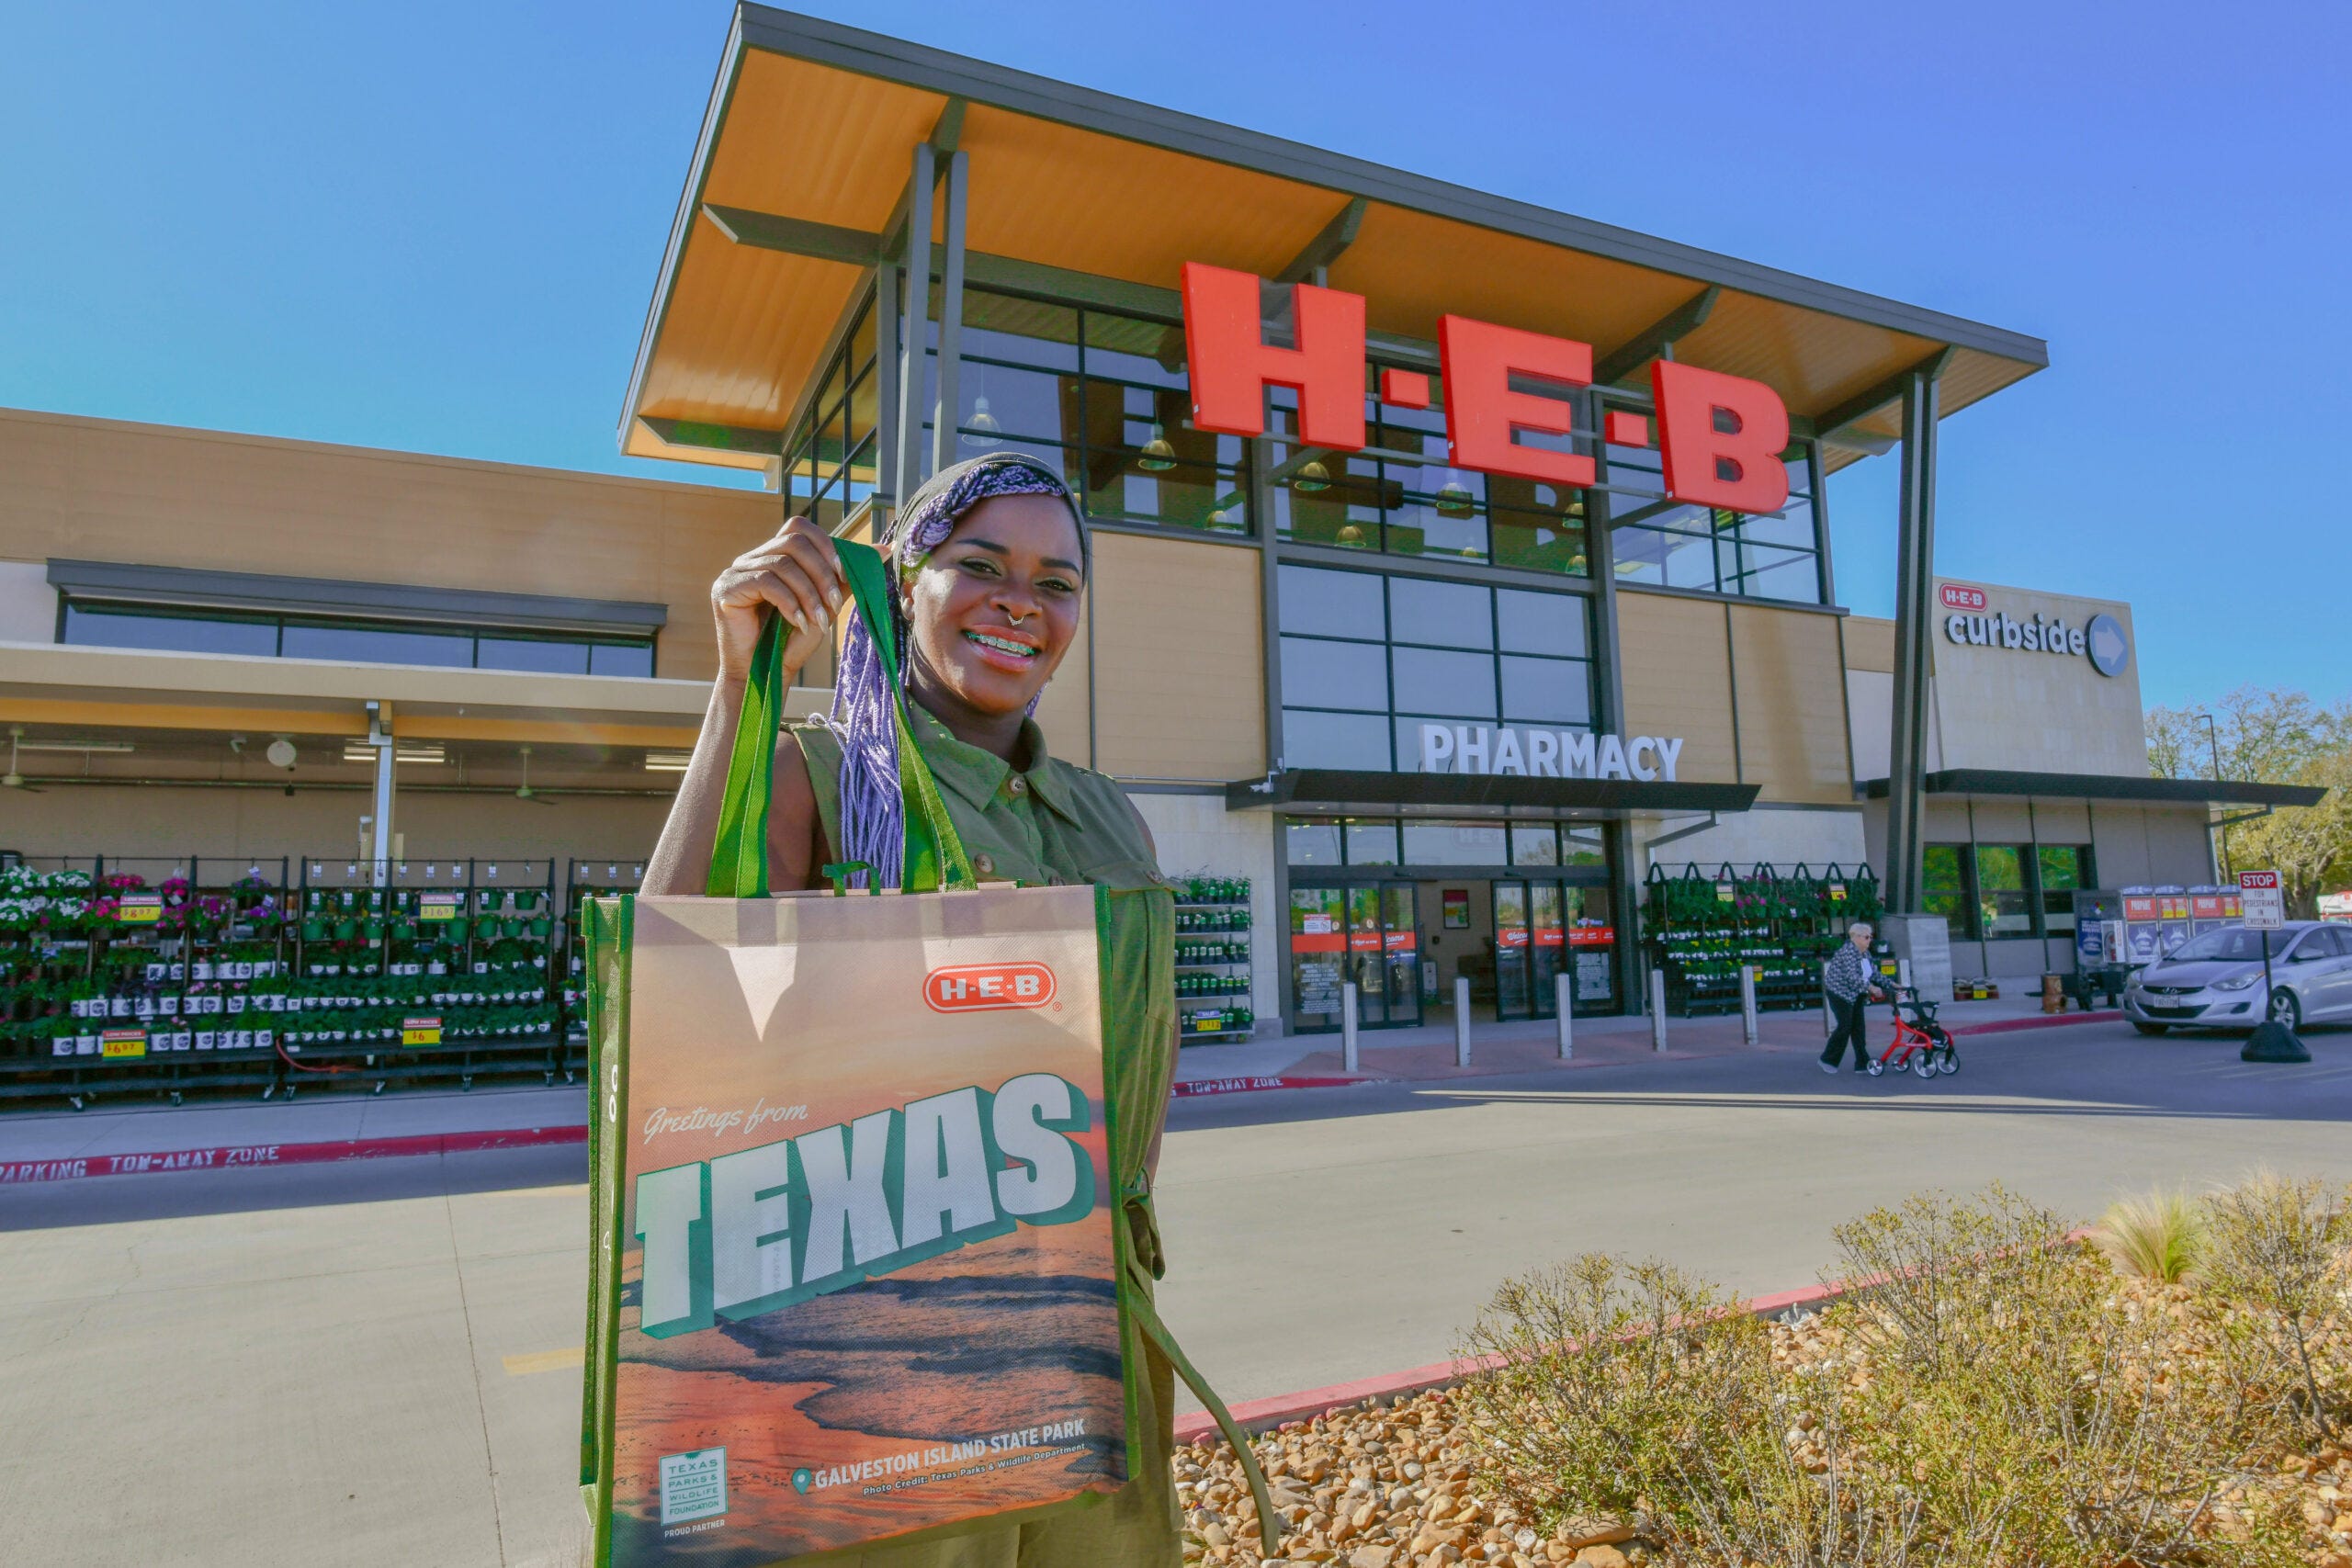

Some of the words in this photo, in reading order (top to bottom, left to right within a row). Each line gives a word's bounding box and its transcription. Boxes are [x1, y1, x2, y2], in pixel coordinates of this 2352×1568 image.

[1181, 261, 1790, 514] H-E-B
[1945, 589, 1984, 606] H-E-B
[1945, 611, 2086, 656] curbside
[1420, 724, 1684, 782] PHARMACY
[2243, 874, 2274, 886] STOP
[2243, 899, 2278, 908] PEDESTRIANS
[2254, 890, 2265, 898] FOR
[2258, 908, 2264, 917] IN
[941, 975, 1040, 1000] H-E-B
[1186, 1078, 1248, 1094] TOW-AWAY
[1252, 1077, 1283, 1089] ZONE
[644, 1106, 744, 1145] Greetings
[742, 1098, 808, 1134] from
[110, 1150, 216, 1173] TOW-AWAY
[226, 1145, 280, 1164] ZONE
[636, 1073, 1091, 1337] TEXAS
[815, 1452, 920, 1489] GALVESTON
[924, 1438, 986, 1467] ISLAND
[990, 1428, 1038, 1454] STATE
[1043, 1417, 1085, 1442] PARK
[668, 1459, 718, 1474] TEXAS
[863, 1483, 893, 1496] Photo
[895, 1475, 929, 1490] Credit:
[931, 1471, 957, 1483] Texas
[960, 1465, 986, 1477] Parks
[988, 1463, 995, 1472] &
[997, 1455, 1032, 1469] Wildlife
[1034, 1443, 1085, 1461] Department
[668, 1475, 707, 1488] PARKS
[669, 1487, 719, 1501] WILDLIFE
[669, 1500, 719, 1516] FOUNDATION
[664, 1526, 691, 1539] PROUD
[692, 1518, 726, 1533] PARTNER
